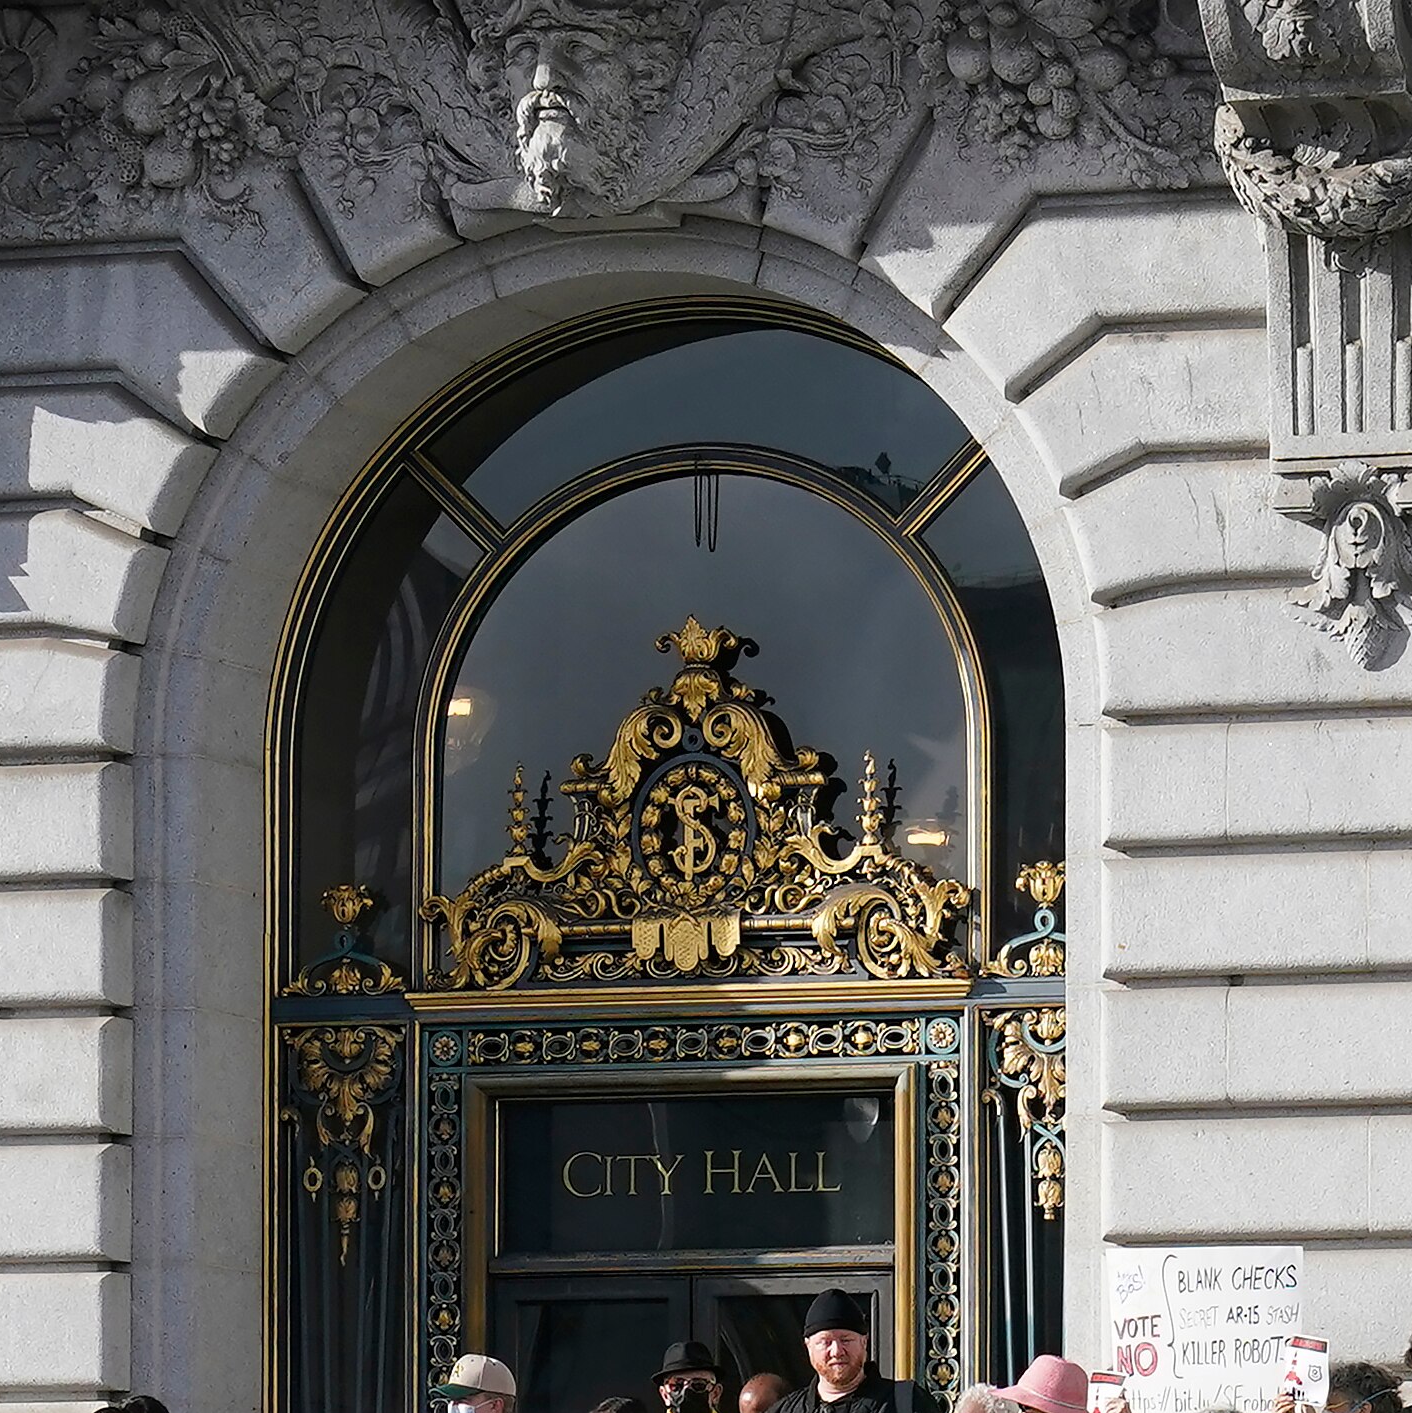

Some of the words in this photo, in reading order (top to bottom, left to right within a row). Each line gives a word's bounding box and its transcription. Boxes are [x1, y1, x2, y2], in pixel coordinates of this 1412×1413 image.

[562, 1151, 685, 1198] CITY
[703, 1150, 842, 1194] HALL
[1178, 1267, 1223, 1293] BLANK
[1231, 1264, 1298, 1291] CHECKS
[1113, 1314, 1162, 1339] VOTE
[1266, 1302, 1300, 1326] STASH
[1117, 1341, 1159, 1378] NO
[1181, 1338, 1227, 1368] KILLER
[1234, 1335, 1291, 1368] ROBOT
